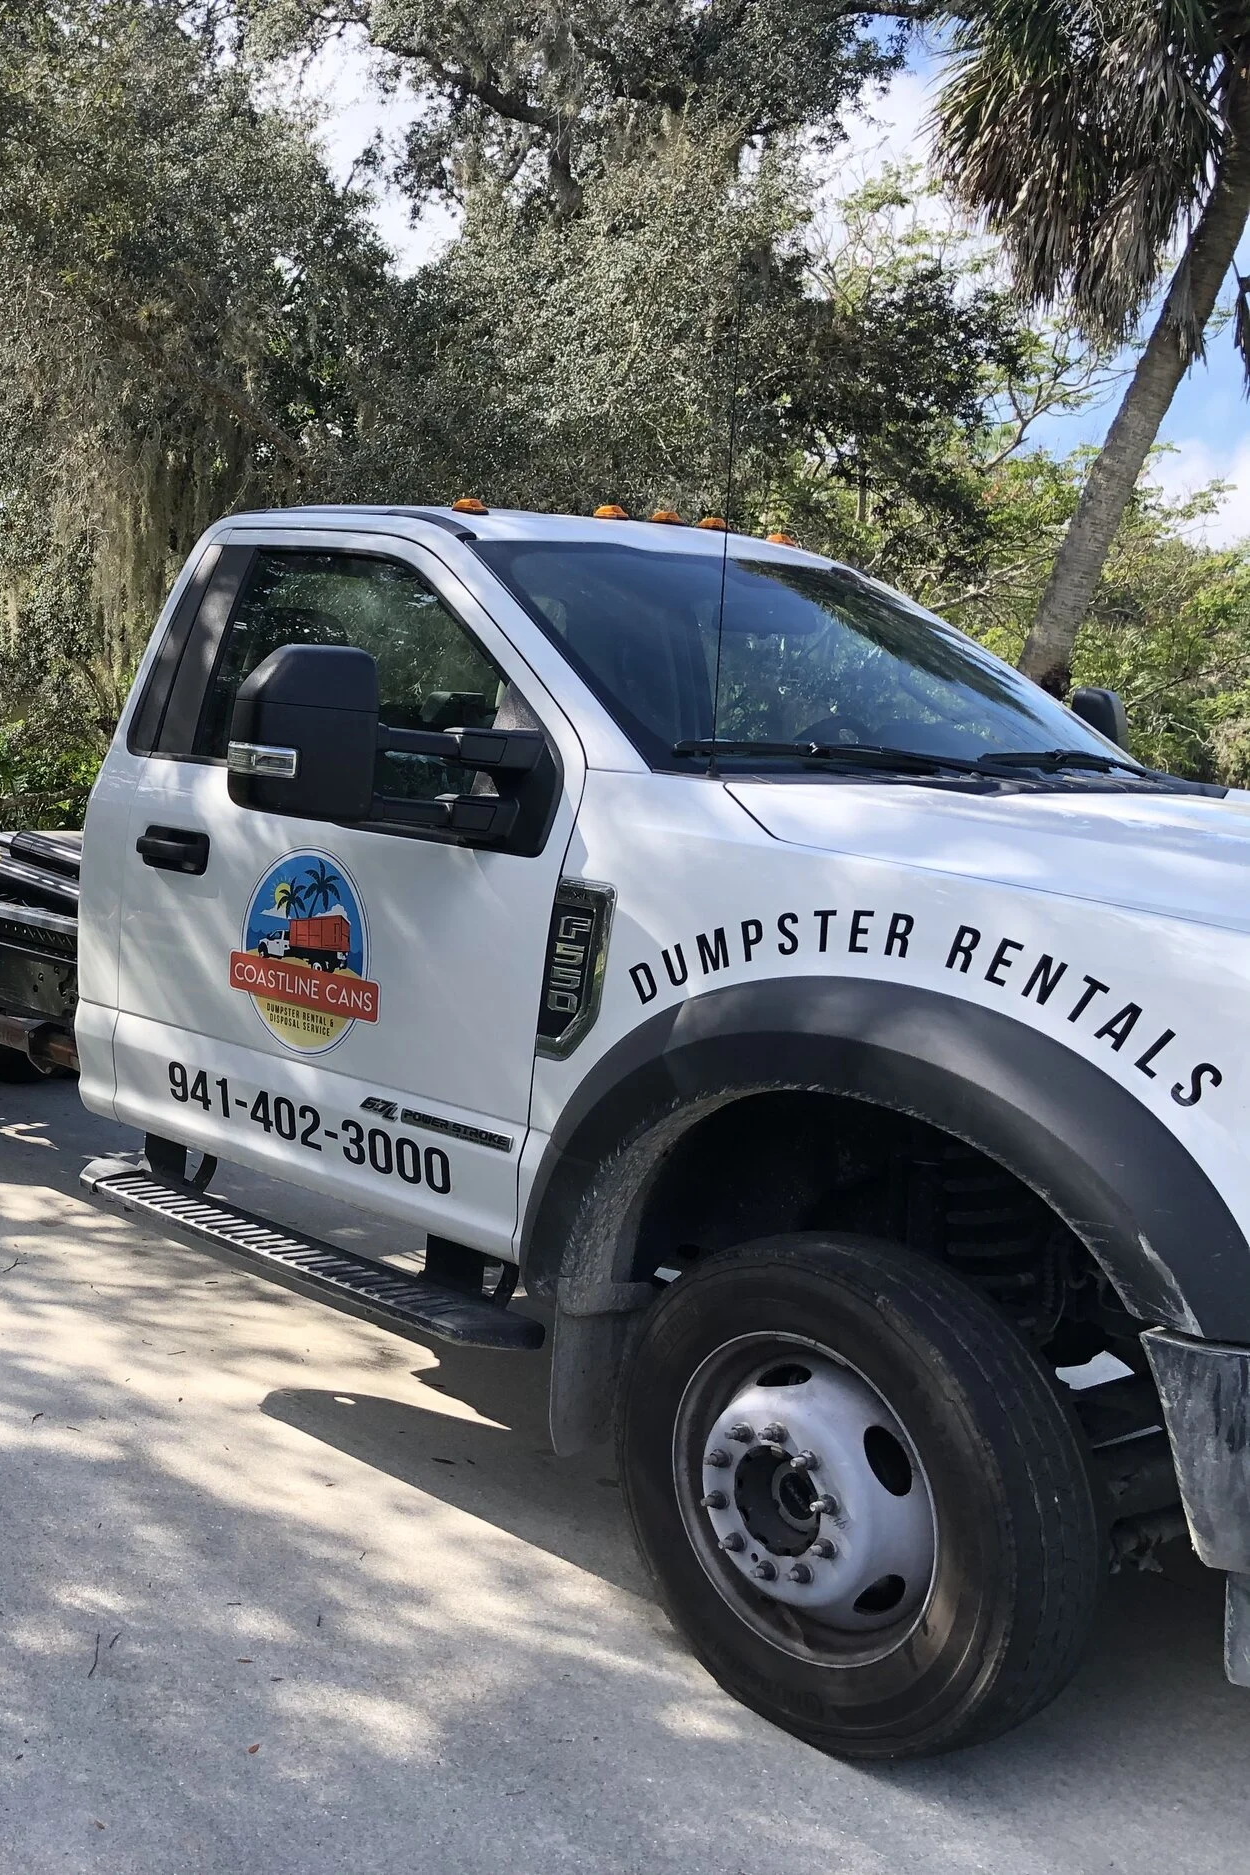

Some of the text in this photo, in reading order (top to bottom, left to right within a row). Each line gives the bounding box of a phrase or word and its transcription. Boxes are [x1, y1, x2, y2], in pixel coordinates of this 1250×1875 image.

[234, 962, 373, 1012] COASTLINE CANS
[629, 909, 1223, 1108] DUMPSTER RENTALS
[266, 1002, 334, 1027] DUMPSTER RENTAL &
[269, 1013, 330, 1036] DISPOSAL SERVICE
[168, 1061, 451, 1195] 941-402-3000
[403, 1108, 449, 1129] POWER
[451, 1123, 510, 1146] STROKE
